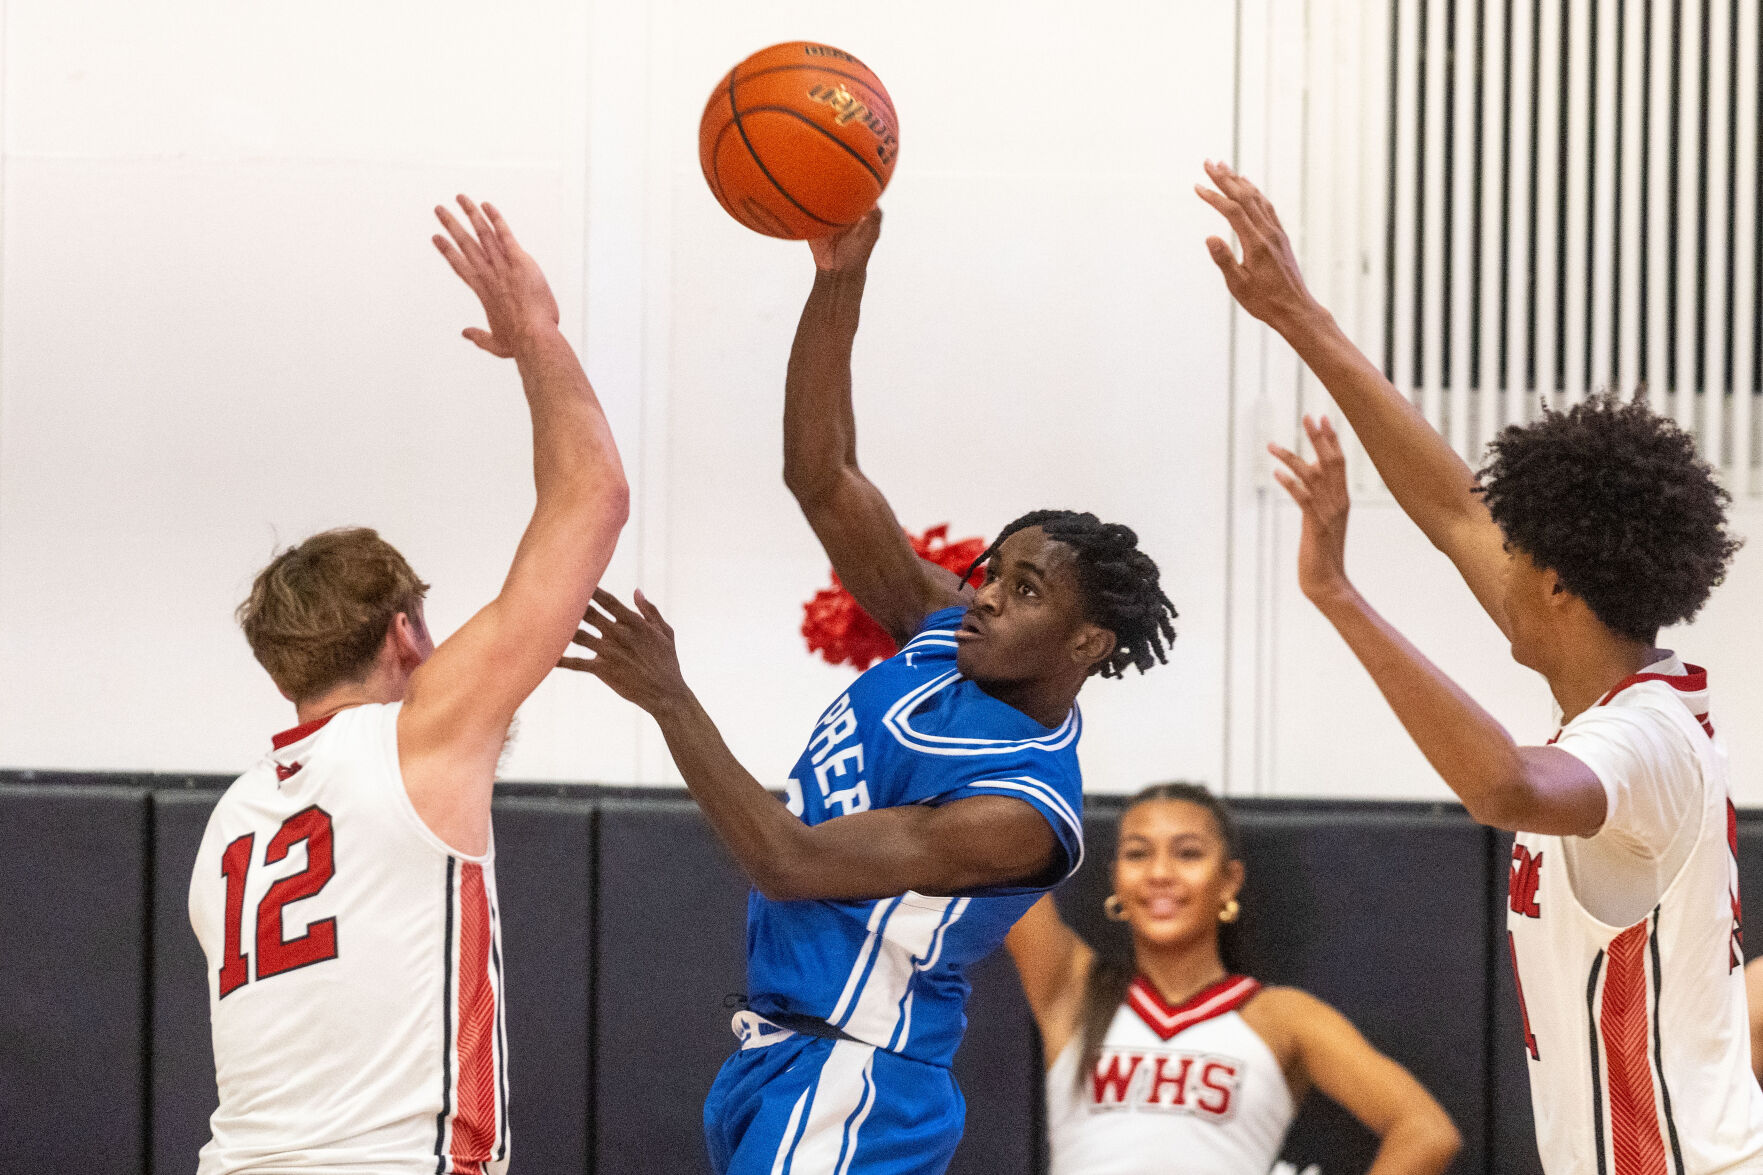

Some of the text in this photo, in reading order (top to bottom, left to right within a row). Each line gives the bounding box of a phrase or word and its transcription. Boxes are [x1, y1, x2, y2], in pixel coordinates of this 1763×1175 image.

[808, 692, 872, 816] PREP
[218, 803, 339, 1001] 12
[1090, 1054, 1236, 1115] WHS
